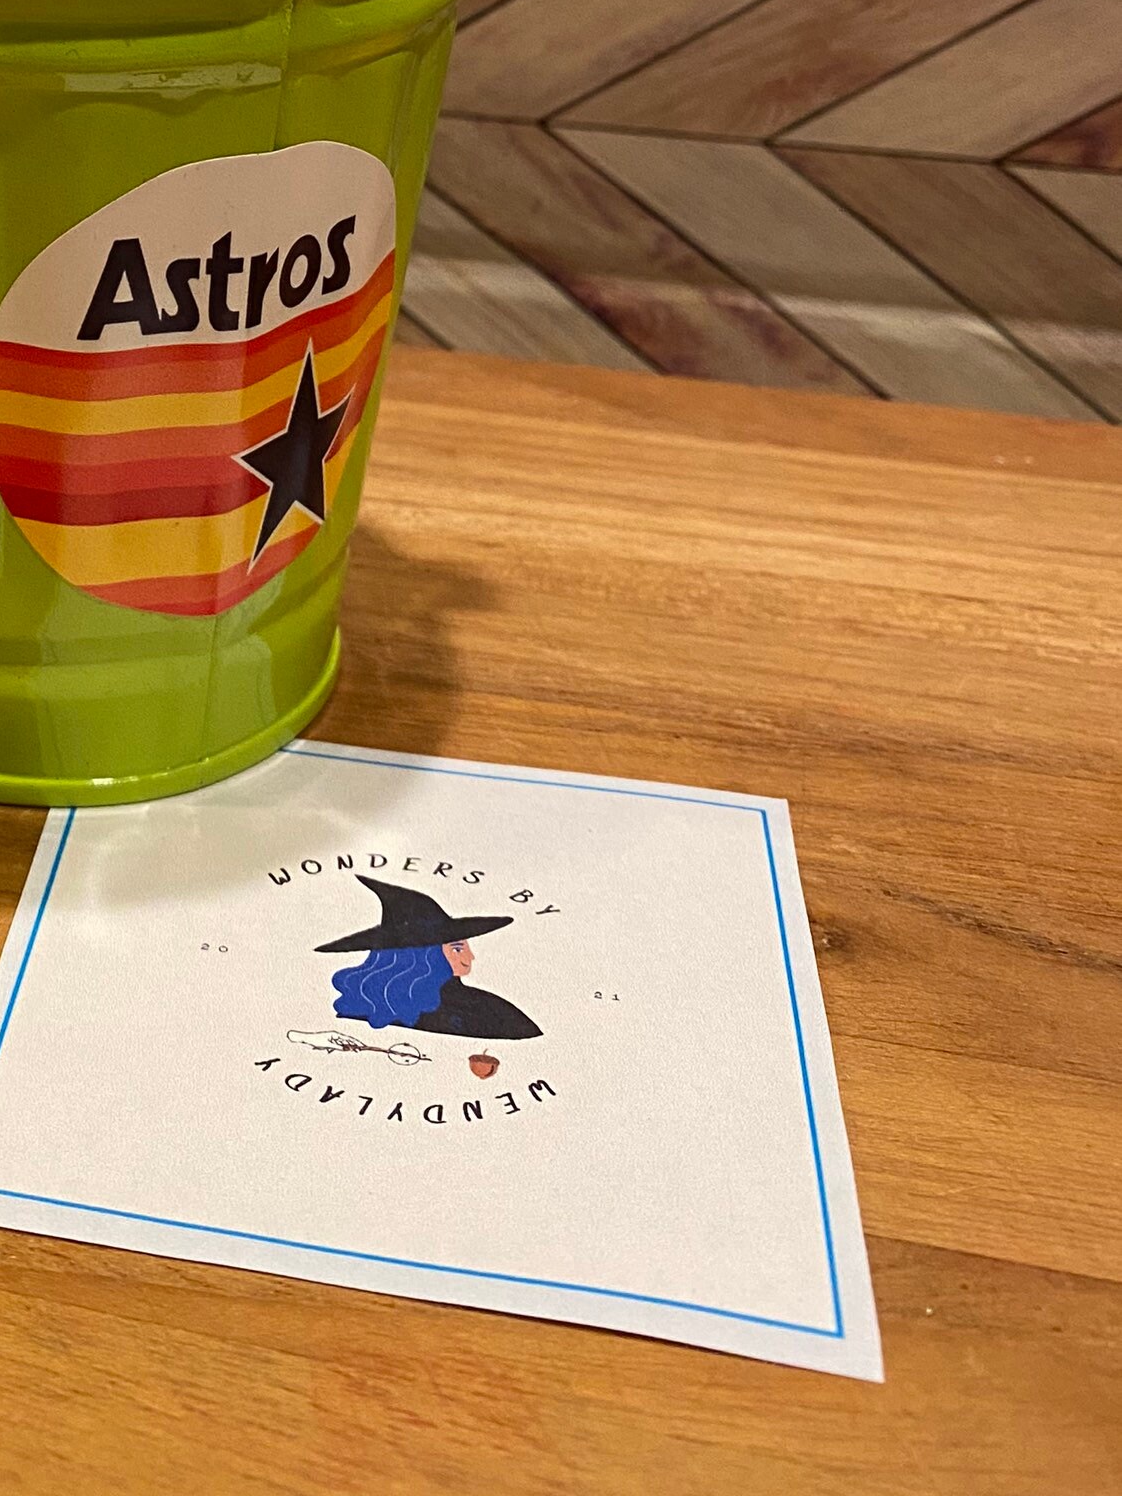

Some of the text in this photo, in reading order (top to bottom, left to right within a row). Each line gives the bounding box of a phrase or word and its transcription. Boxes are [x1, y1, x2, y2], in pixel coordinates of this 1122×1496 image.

[76, 215, 356, 341] Astros
[268, 853, 560, 917] WONDERS BY
[200, 942, 229, 954] 20
[254, 1057, 557, 1124] WENDYLADY
